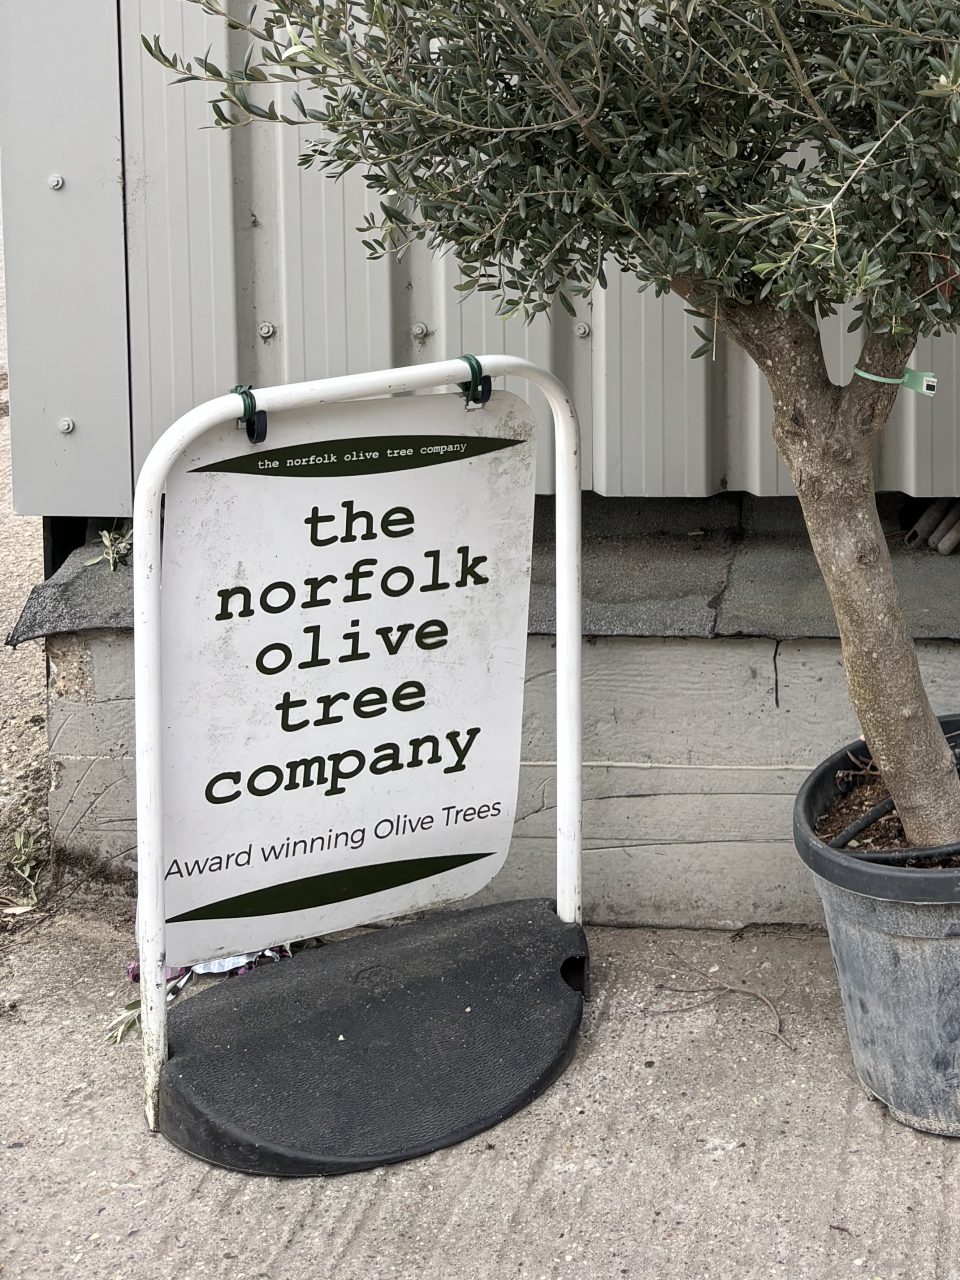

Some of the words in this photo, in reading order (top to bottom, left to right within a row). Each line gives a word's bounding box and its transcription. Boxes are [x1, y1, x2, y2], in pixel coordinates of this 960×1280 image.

[257, 459, 280, 469] the
[286, 453, 338, 467] norfolk
[343, 450, 380, 462] olive
[386, 448, 414, 458] tree
[420, 442, 467, 455] company
[304, 500, 414, 546] the
[215, 546, 489, 620] norfolk
[256, 620, 448, 675] olive
[275, 681, 425, 732] tree
[205, 727, 480, 805] company
[165, 844, 252, 880] Award
[261, 828, 365, 861] winning
[374, 815, 433, 839] Olive
[442, 802, 501, 826] Trees
